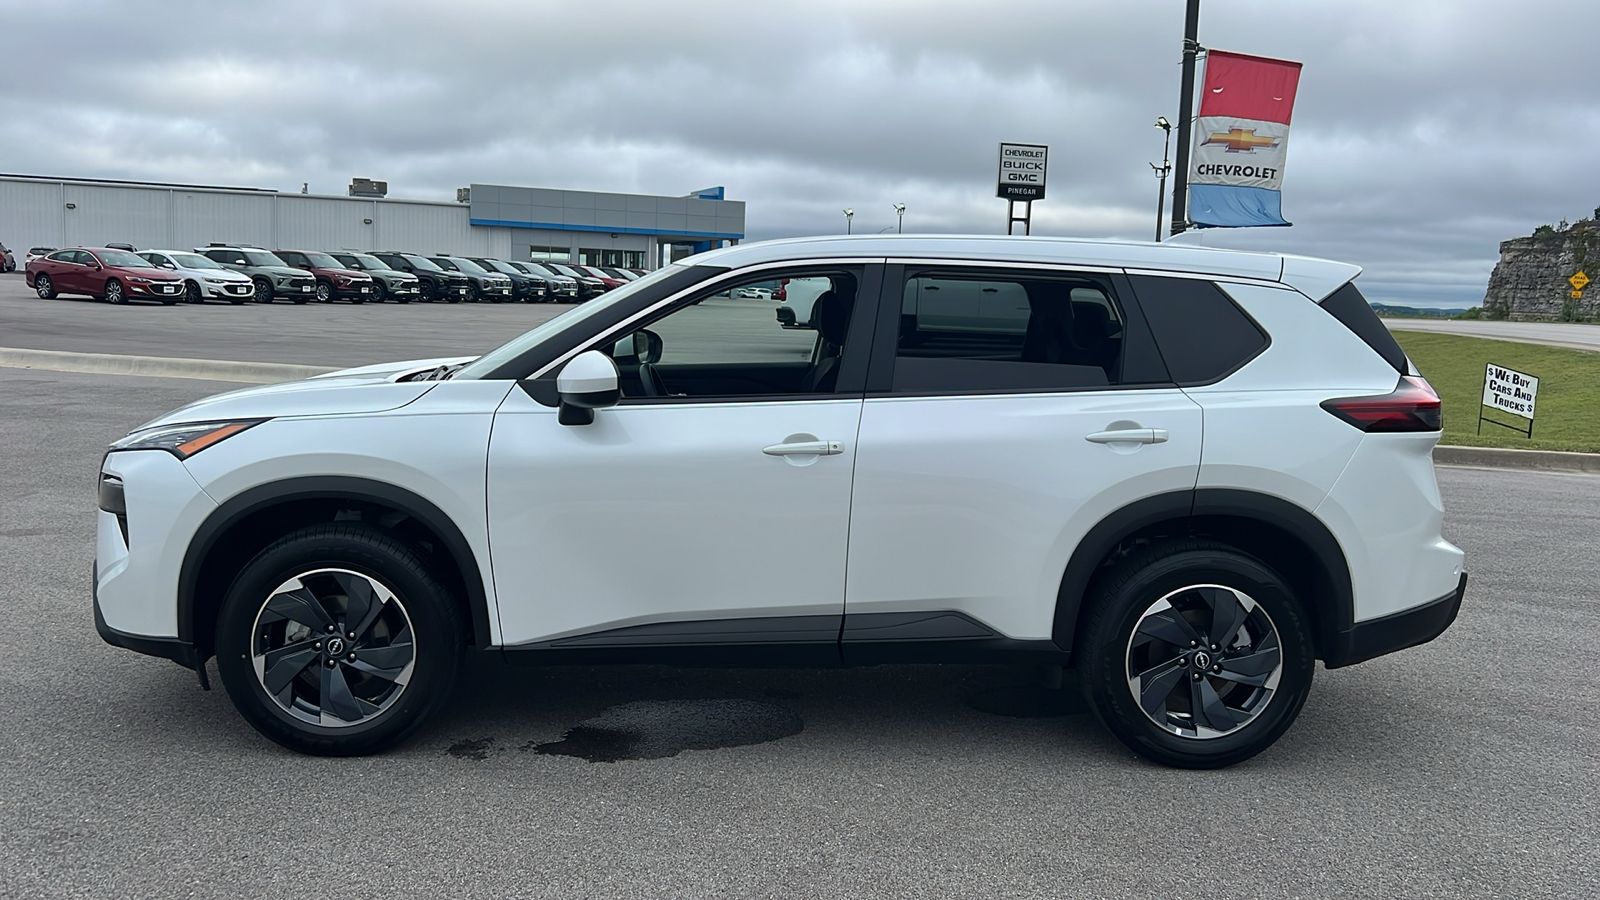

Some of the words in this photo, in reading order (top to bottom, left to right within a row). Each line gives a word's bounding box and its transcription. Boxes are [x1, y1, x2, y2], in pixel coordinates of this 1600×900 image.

[1005, 149, 1043, 158] CHEVROLET
[1003, 161, 1043, 170] BUICK
[1197, 164, 1277, 179] CHEVROLET
[1008, 173, 1037, 182] GMC
[1007, 187, 1036, 195] PINEGAR
[1512, 373, 1530, 388] BUY
[1489, 379, 1512, 396] CARS
[1514, 387, 1532, 402] AND
[1493, 392, 1525, 412] TRUCKS
